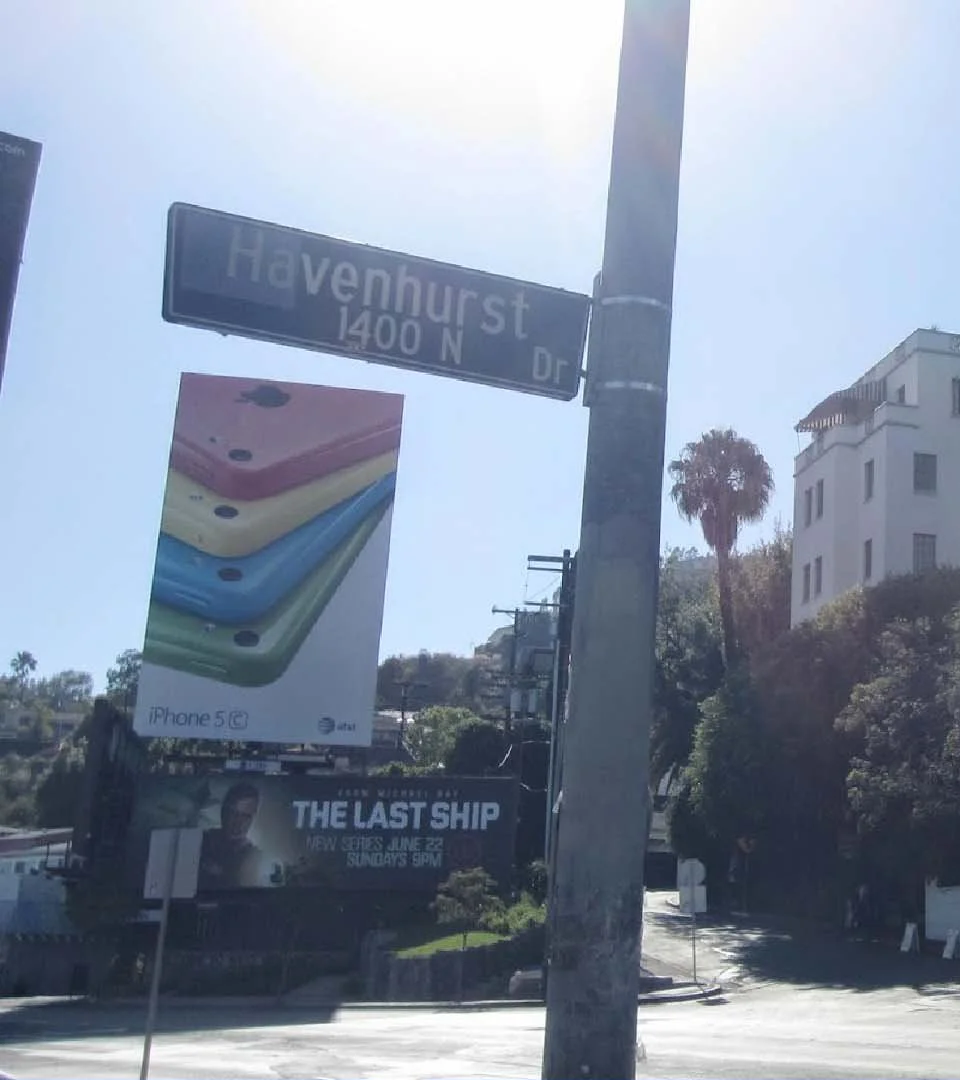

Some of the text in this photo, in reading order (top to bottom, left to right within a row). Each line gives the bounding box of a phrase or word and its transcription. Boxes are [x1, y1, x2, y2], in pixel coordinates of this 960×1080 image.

[226, 225, 529, 340] Havenhurst
[338, 306, 463, 365] 1400 N
[531, 346, 568, 384] Dr
[149, 706, 210, 727] iPhone
[292, 800, 500, 831] THE LAST SHIP
[306, 836, 444, 852] NEW SERIES JUNE 22
[346, 851, 442, 868] SUNDAYS 9PM
